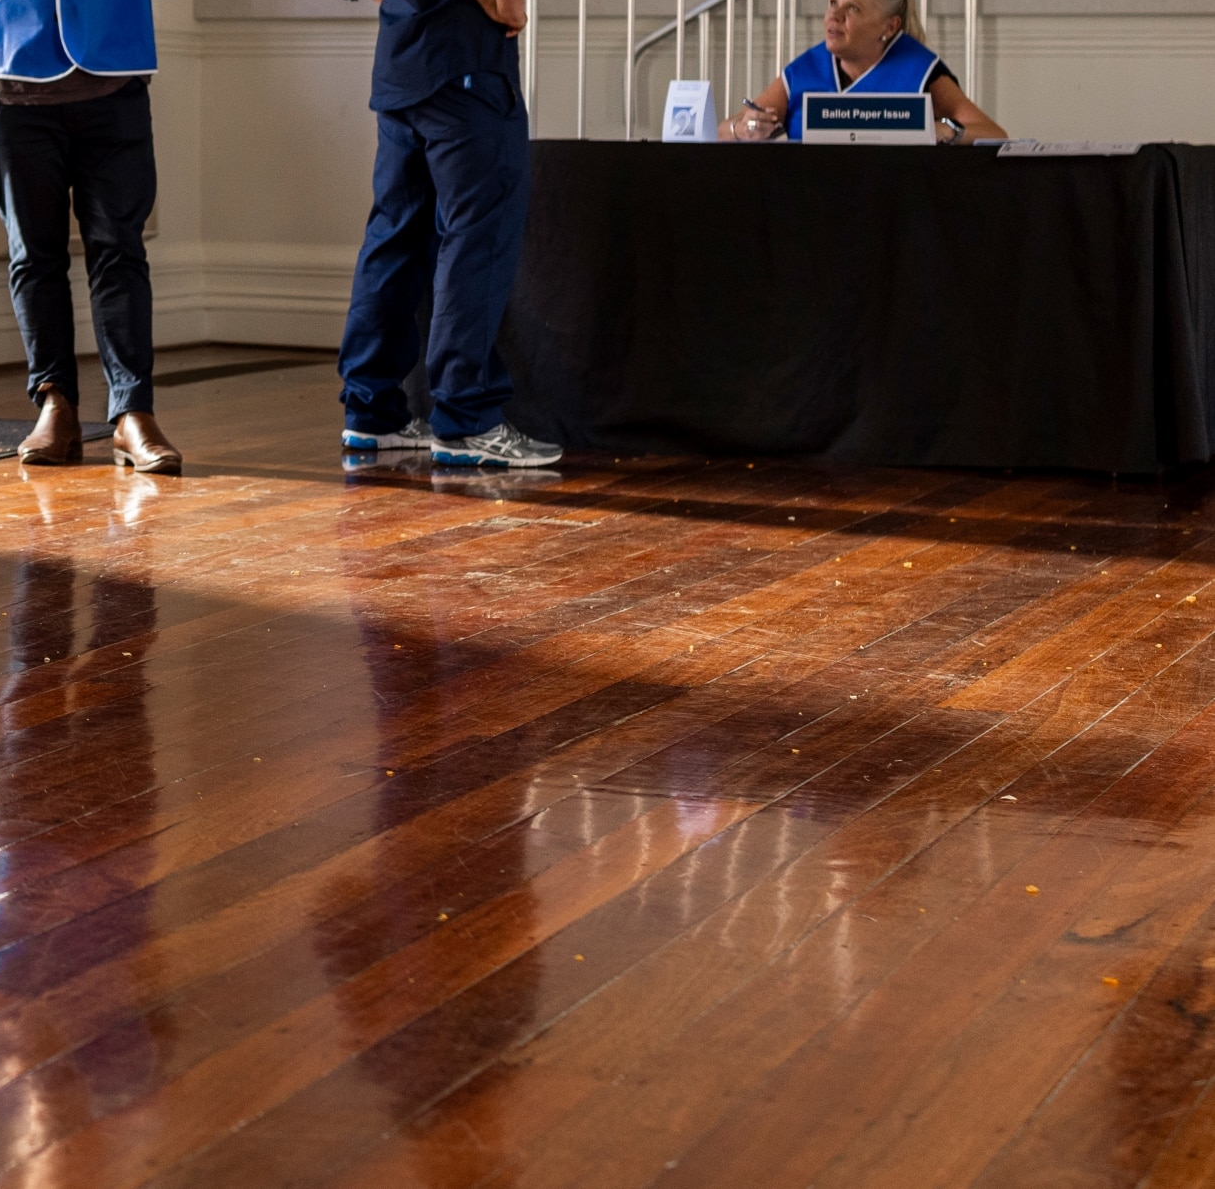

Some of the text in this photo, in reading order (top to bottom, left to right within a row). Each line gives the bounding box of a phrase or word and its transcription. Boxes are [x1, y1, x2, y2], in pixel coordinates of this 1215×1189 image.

[821, 108, 911, 121] Ballot Paper Issue
